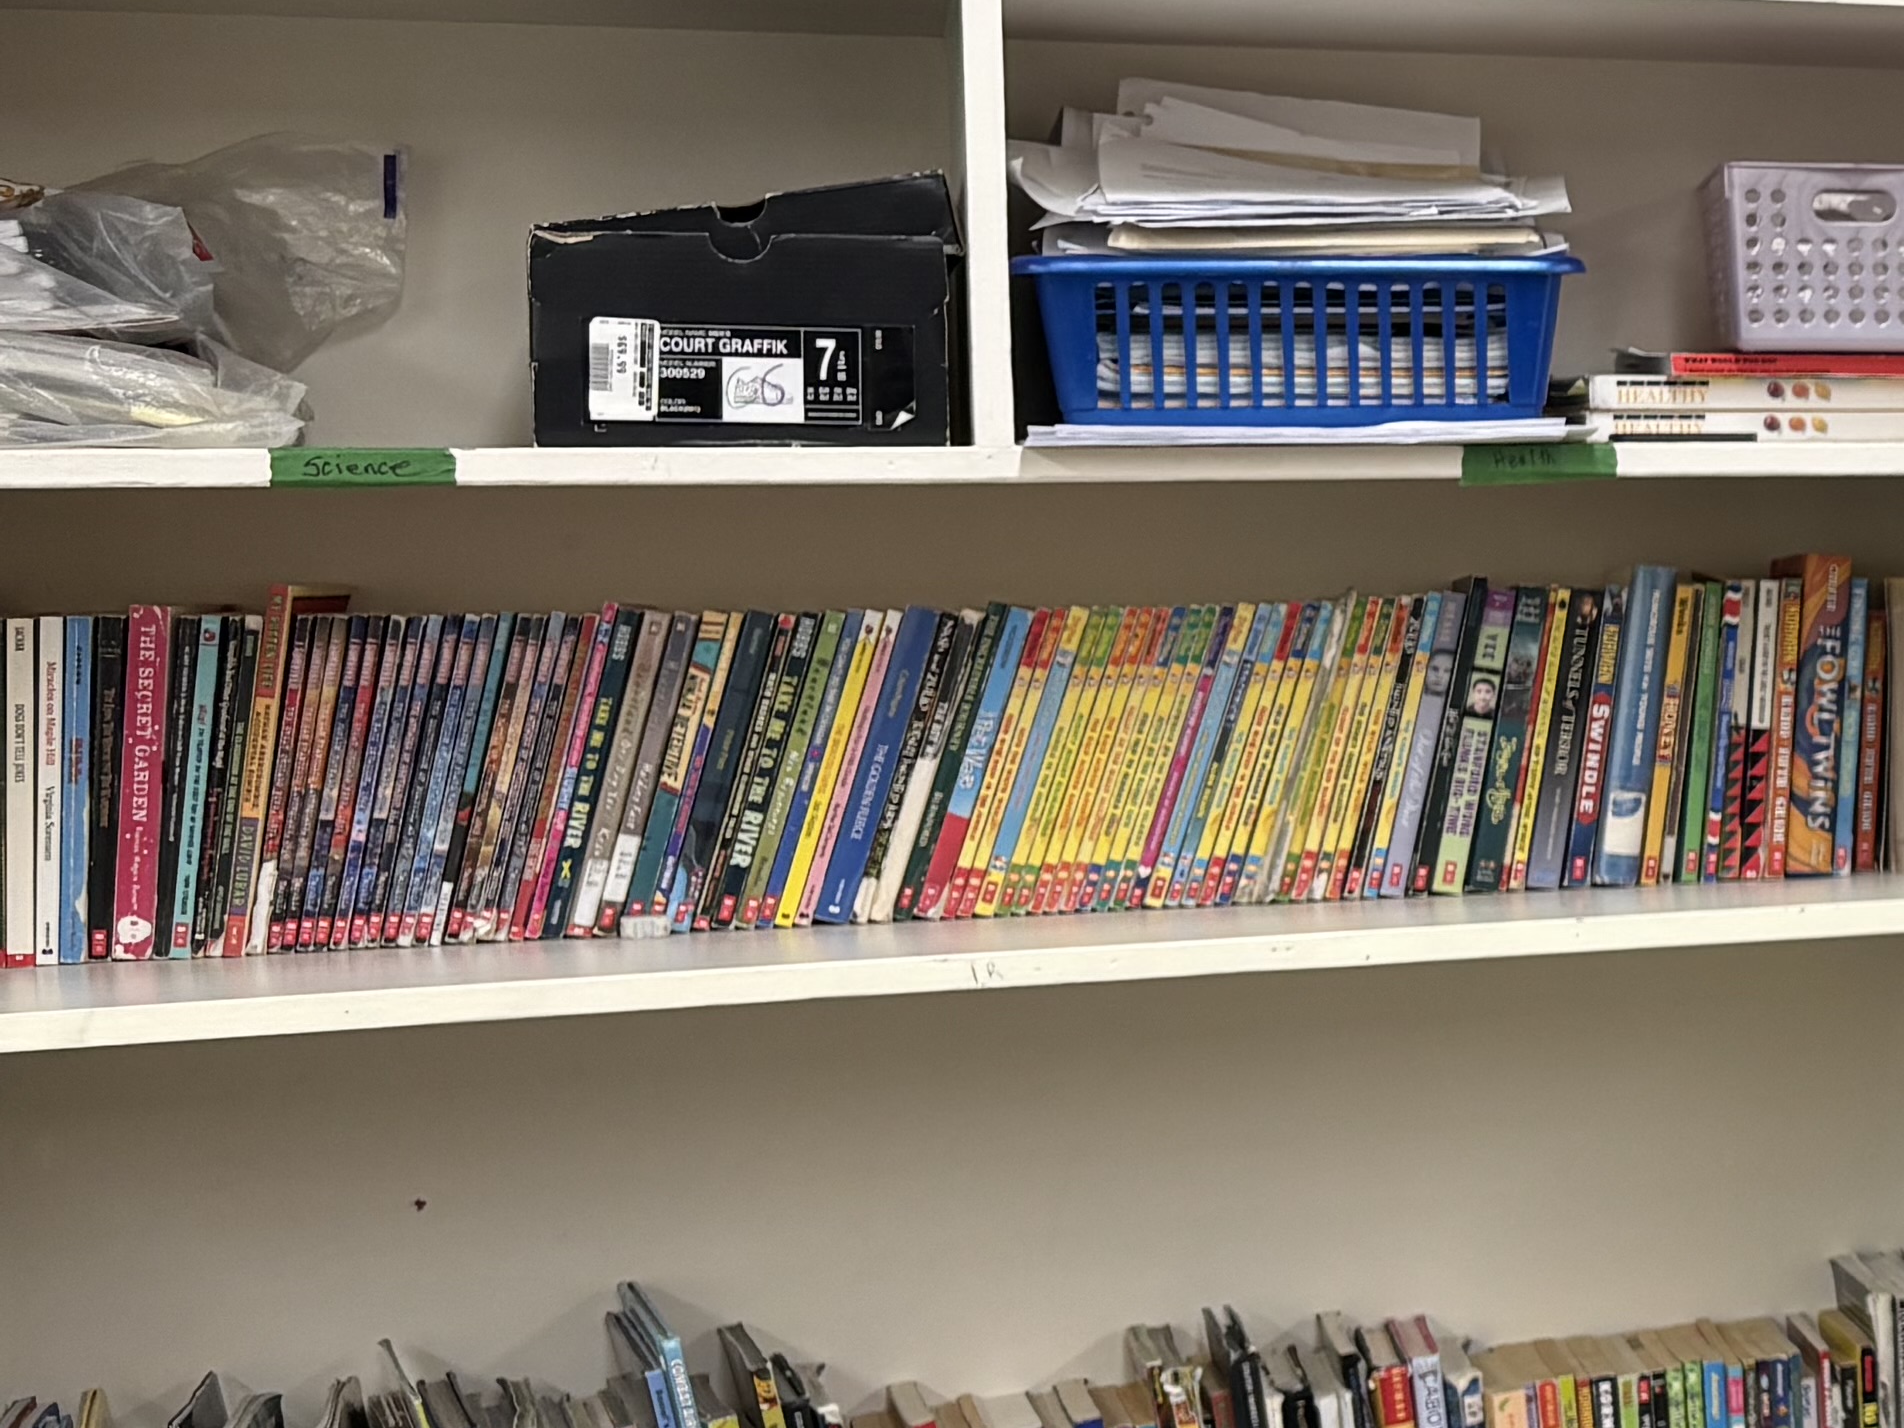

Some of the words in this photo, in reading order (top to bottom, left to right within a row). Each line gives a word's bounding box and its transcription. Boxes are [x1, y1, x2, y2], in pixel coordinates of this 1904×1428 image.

[660, 336, 714, 354] COURT
[719, 338, 788, 356] GRAFFIK
[815, 338, 837, 381] 7
[1617, 385, 1709, 405] HEALTHY
[302, 454, 420, 477] Science
[139, 624, 156, 660] THE
[1819, 624, 1840, 637] THE
[44, 661, 58, 701] Miracles
[1564, 627, 1588, 700] TUNNELS
[1811, 637, 1840, 728] FOWL
[45, 702, 54, 715] on
[133, 667, 154, 738] SECRET
[595, 696, 612, 726] TAKE
[680, 672, 701, 713] NINJA
[775, 673, 798, 713] TAKE
[13, 703, 25, 722] DOGS
[41, 716, 56, 746] Maple
[766, 717, 787, 742] ME
[44, 748, 55, 766] Hill
[590, 729, 605, 749] ME
[661, 713, 690, 788] DETECTIVE
[758, 746, 778, 769] TO
[873, 743, 888, 763] THE
[1553, 712, 1576, 776] TERROR
[1578, 702, 1610, 814] SWINDLE
[13, 762, 25, 783] JOKES
[584, 752, 599, 770] TO
[1466, 729, 1488, 797] STANFORD
[1805, 727, 1835, 829] TWINS
[130, 745, 150, 821] GARDEN
[577, 774, 593, 796] THE
[747, 773, 770, 804] THE
[860, 762, 883, 806] GOLDEN
[42, 785, 55, 820] Virginia
[1445, 777, 1465, 836] BIG-TIME
[564, 800, 589, 849] RIVER
[729, 808, 763, 869] RIVER
[850, 805, 870, 841] FLEECE
[236, 825, 255, 865] DAVID
[230, 867, 250, 907] LUBAR
[668, 1357, 693, 1409] COMBAT
